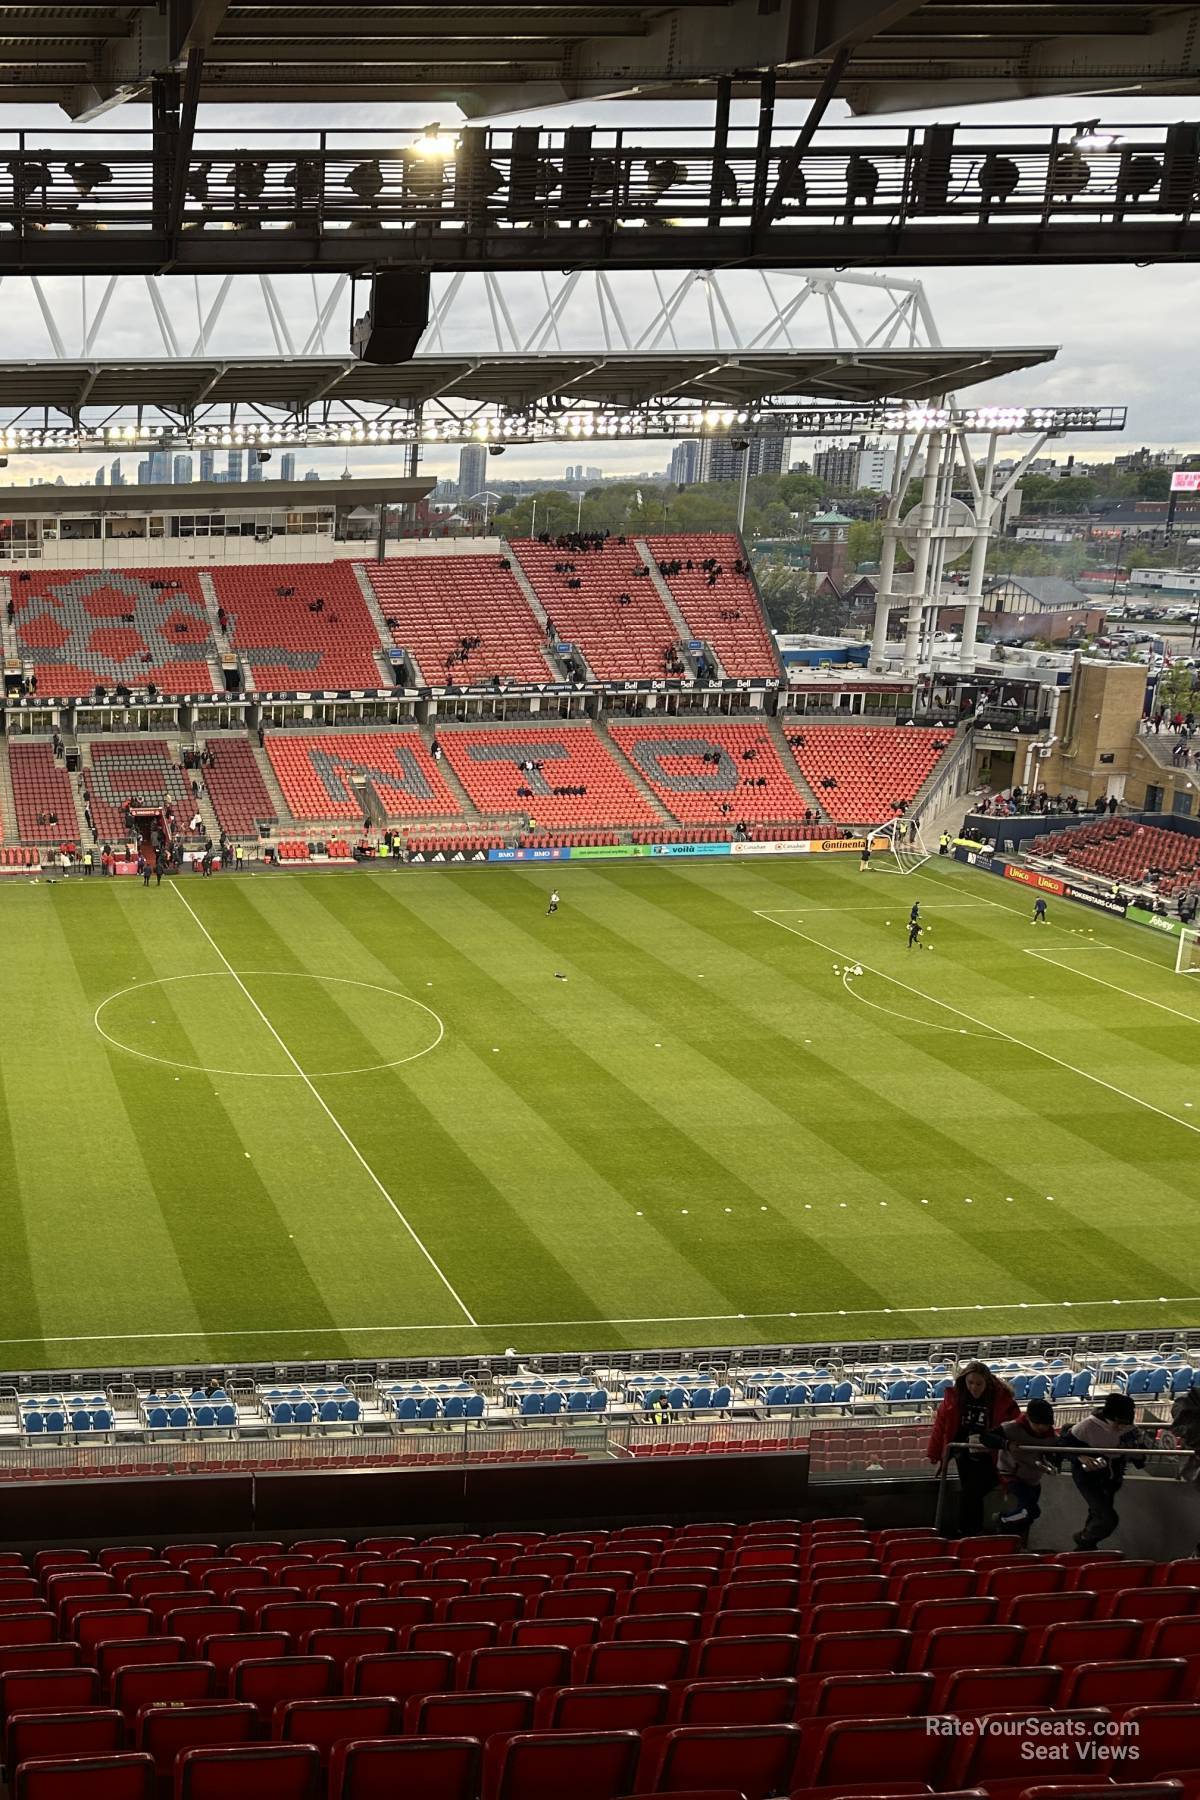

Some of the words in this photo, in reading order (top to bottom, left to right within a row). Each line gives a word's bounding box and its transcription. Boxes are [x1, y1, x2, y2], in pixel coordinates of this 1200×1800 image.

[624, 682, 638, 690] Bell
[652, 681, 666, 689] Bell
[680, 680, 695, 688] Bell
[708, 679, 723, 688] Bell
[736, 679, 751, 688] Bell
[765, 679, 780, 687] Bell
[672, 845, 695, 853] voilà
[1071, 889, 1106, 906] POKERSTARS
[1105, 901, 1125, 913] CASINO
